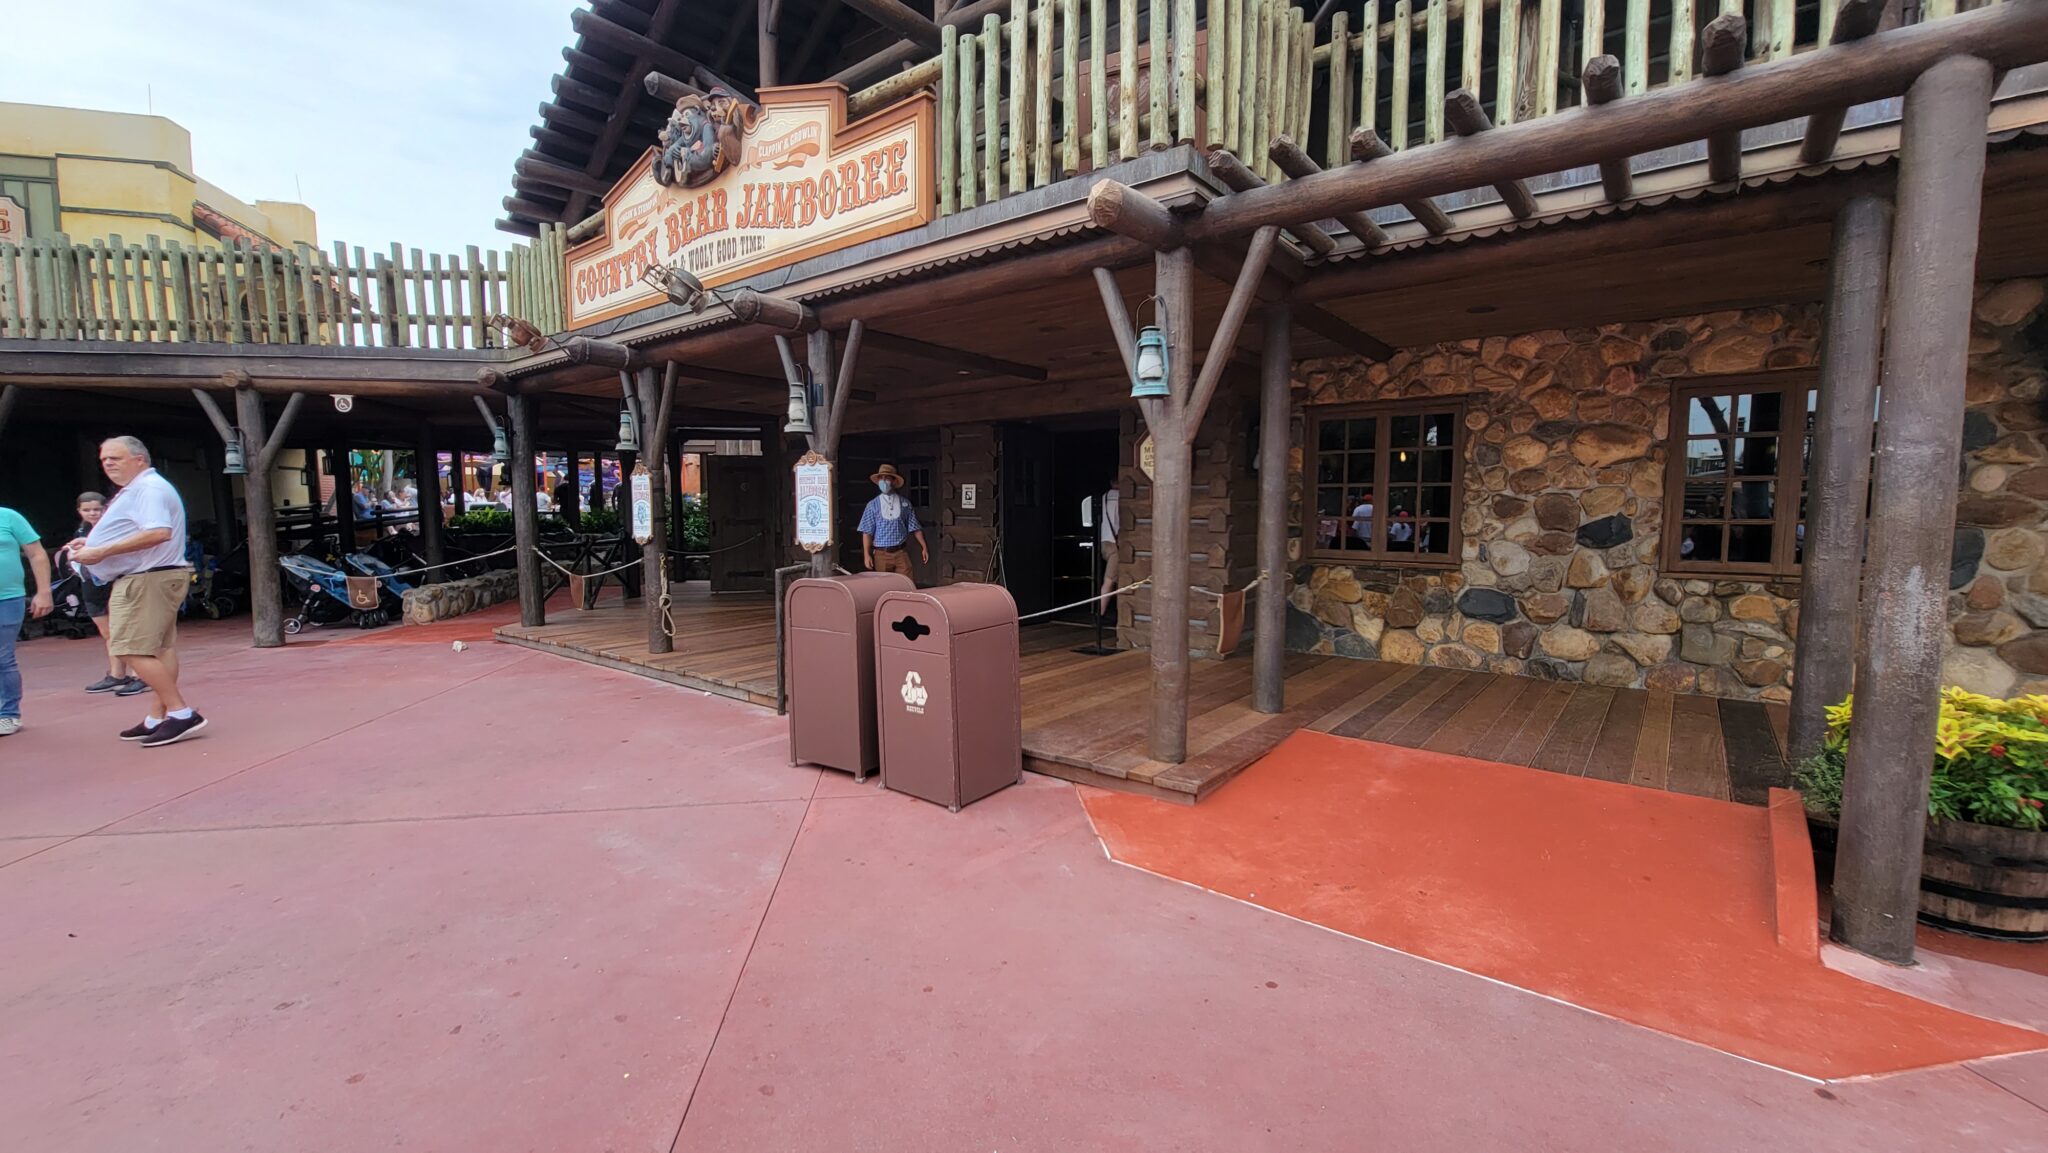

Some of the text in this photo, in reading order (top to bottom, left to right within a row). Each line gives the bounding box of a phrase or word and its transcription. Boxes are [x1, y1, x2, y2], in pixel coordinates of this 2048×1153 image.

[576, 139, 907, 304] COUNTRY BEAR JAMBOREE
[688, 241, 714, 273] WOOLY
[716, 237, 737, 263] GOOD
[740, 235, 765, 256] TIME!
